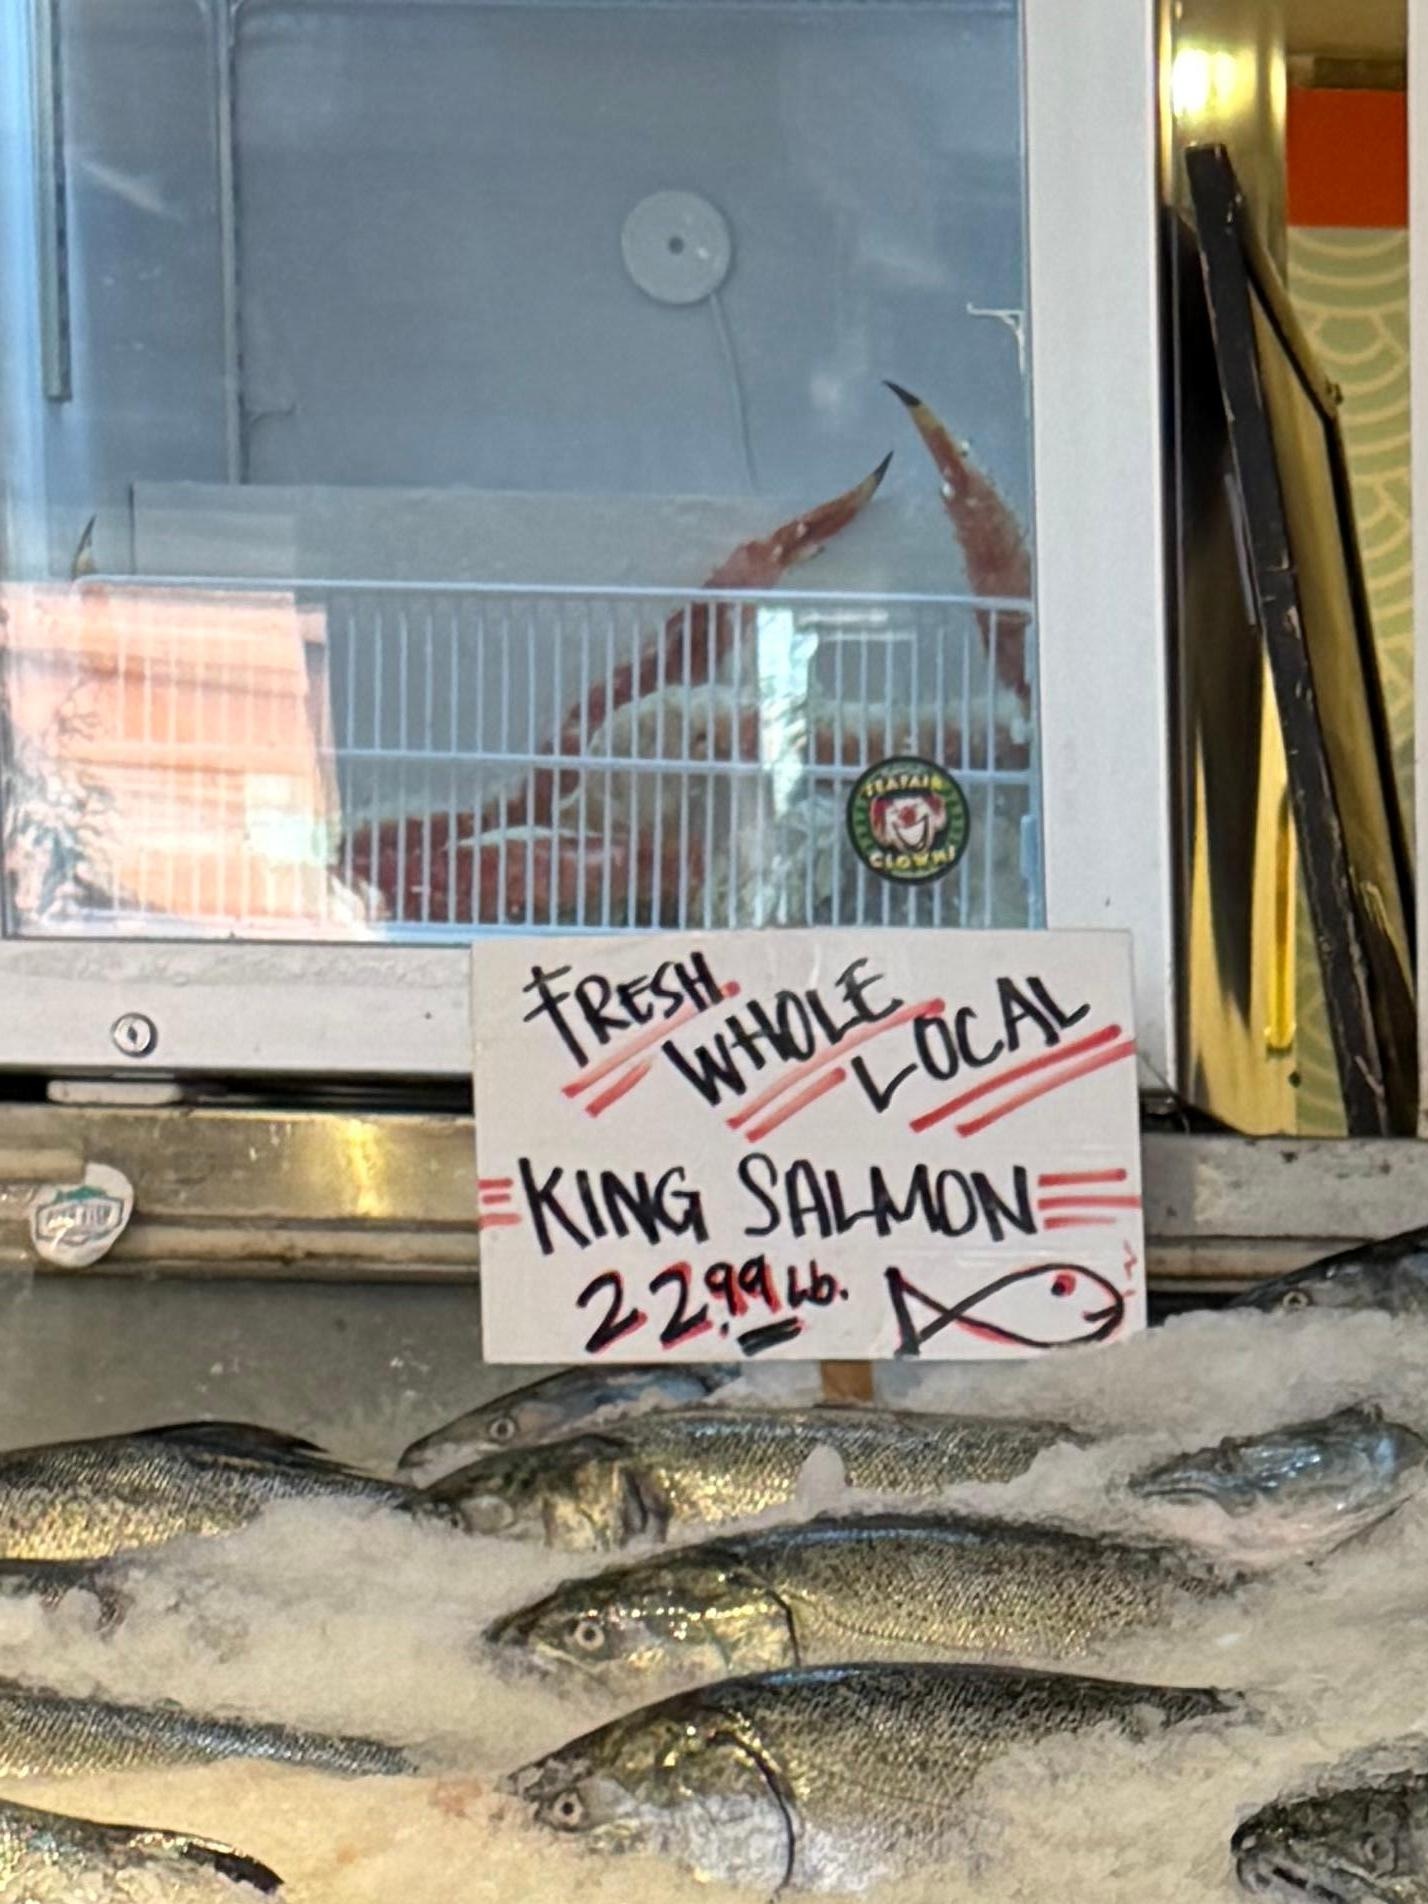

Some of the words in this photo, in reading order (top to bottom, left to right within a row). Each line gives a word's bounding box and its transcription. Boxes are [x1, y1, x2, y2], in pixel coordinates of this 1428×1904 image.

[522, 952, 725, 1068] FRESH
[662, 958, 905, 1107] WHOLE
[852, 976, 1091, 1113] LOCAL
[518, 1157, 704, 1255] KING
[737, 1152, 1038, 1242] SALMON
